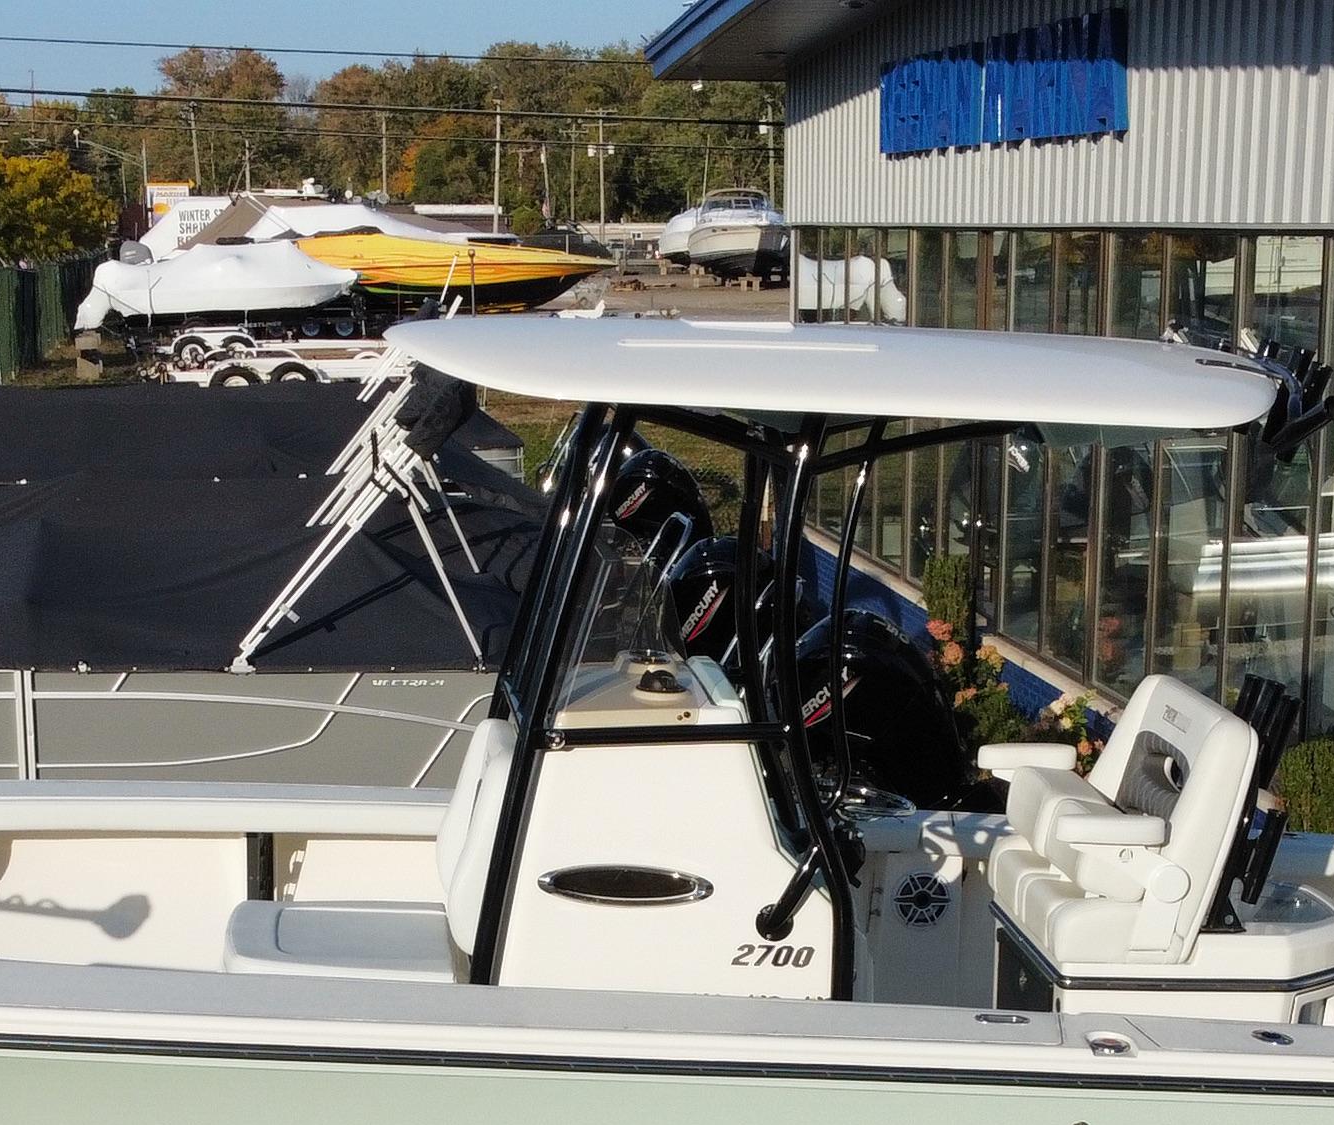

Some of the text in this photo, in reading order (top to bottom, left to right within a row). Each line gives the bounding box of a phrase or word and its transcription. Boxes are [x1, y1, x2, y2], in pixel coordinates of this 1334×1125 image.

[178, 209, 211, 222] WINTER
[615, 482, 647, 519] MERCURY
[682, 579, 719, 640] MERCURY
[731, 943, 816, 968] 2700
